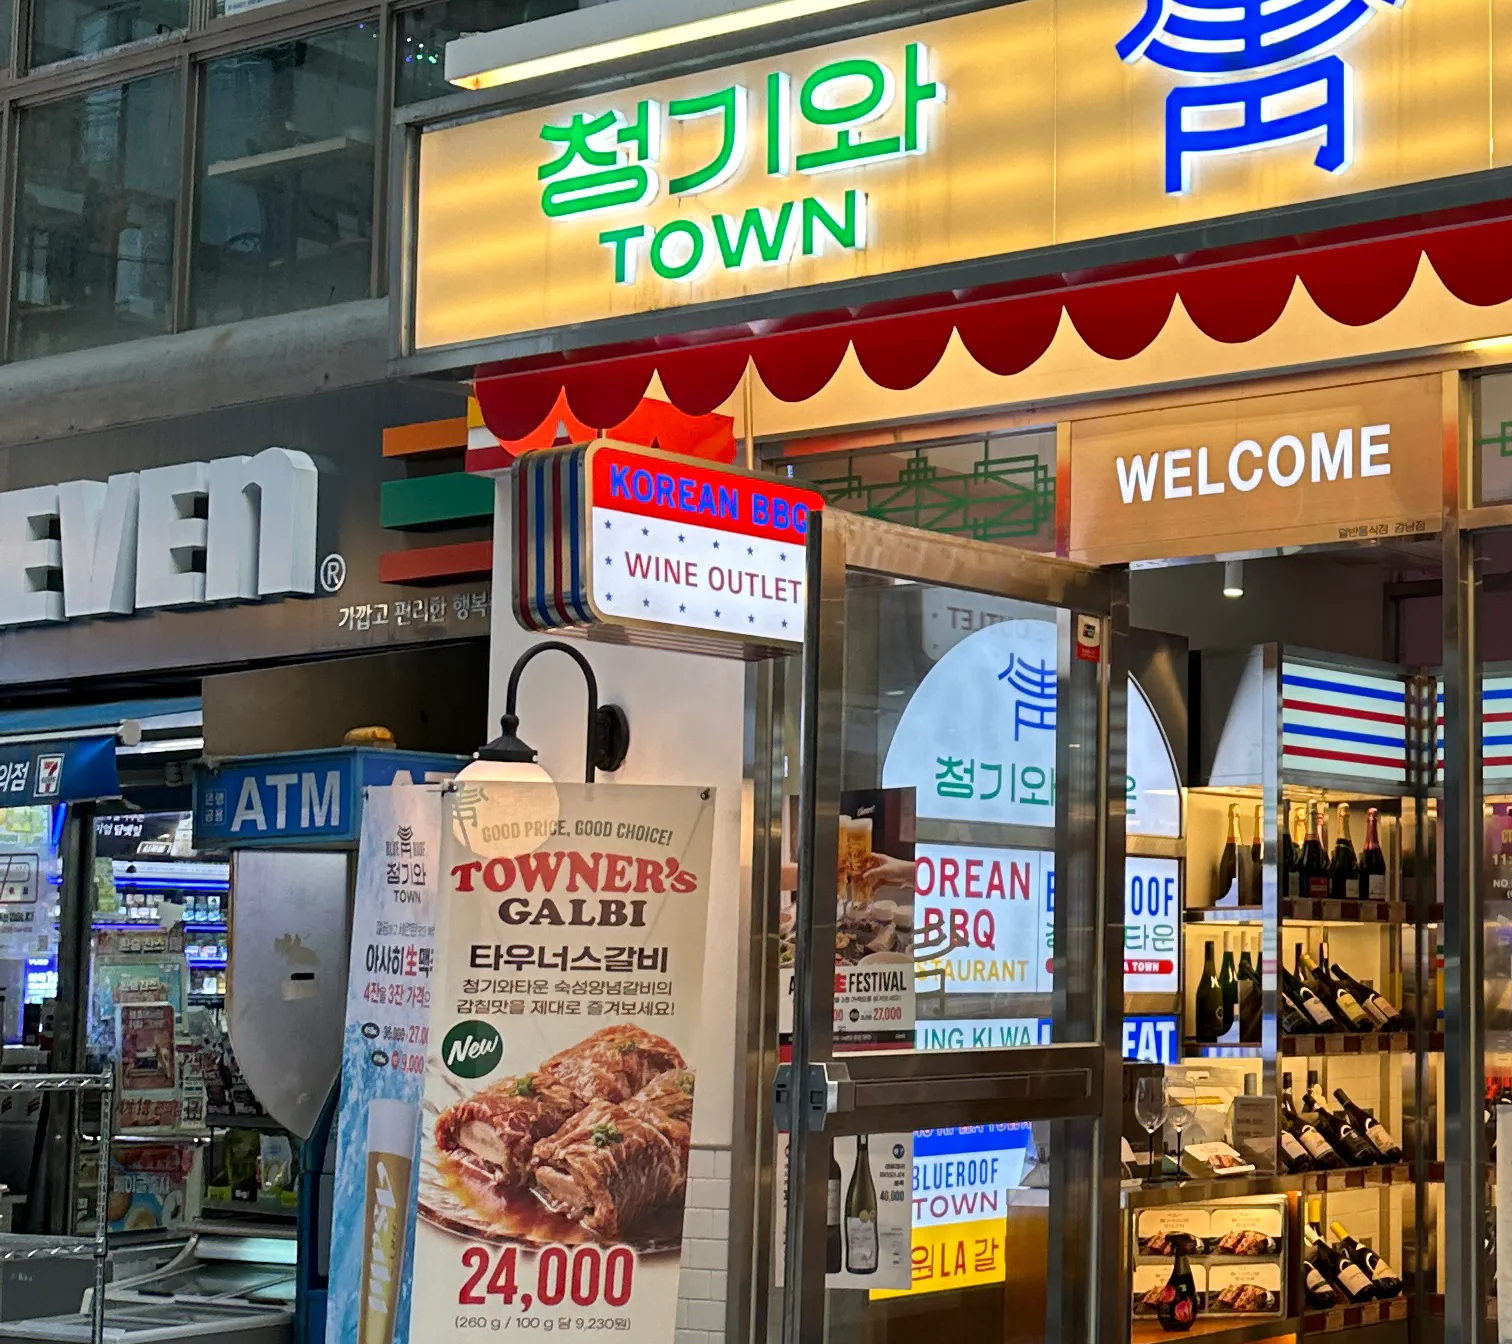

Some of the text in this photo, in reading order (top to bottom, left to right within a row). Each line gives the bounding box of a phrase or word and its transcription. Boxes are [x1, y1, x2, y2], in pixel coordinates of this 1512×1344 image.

[537, 43, 943, 217] 청기와
[599, 190, 862, 284] TOWN
[1116, 423, 1391, 504] WELCOME
[610, 464, 739, 521] KOREAN
[624, 551, 802, 605] WINE OUTLET
[338, 596, 447, 631] 가깝고 편리한
[935, 756, 1056, 807] 청기와
[231, 770, 341, 832] ATM
[481, 819, 674, 847] GOOD PRICE, GOOD CHOICE!
[394, 889, 421, 904] TOWN
[1493, 879, 1508, 888] NO
[498, 897, 648, 928] GALBI
[924, 908, 996, 951] BBQ
[469, 943, 669, 974] 타우너스갈비
[462, 979, 673, 997] 청기와타운 숙성양념갈비의
[849, 971, 907, 993] FESTIVAL
[456, 999, 675, 1017] 감칠맛을 제대로 즐겨보세요!
[447, 1034, 499, 1066] New
[913, 1158, 1000, 1191] BLUEROOF
[914, 1189, 998, 1221] TOWN
[458, 1246, 635, 1313] 24,000
[516, 1317, 540, 1329] 100
